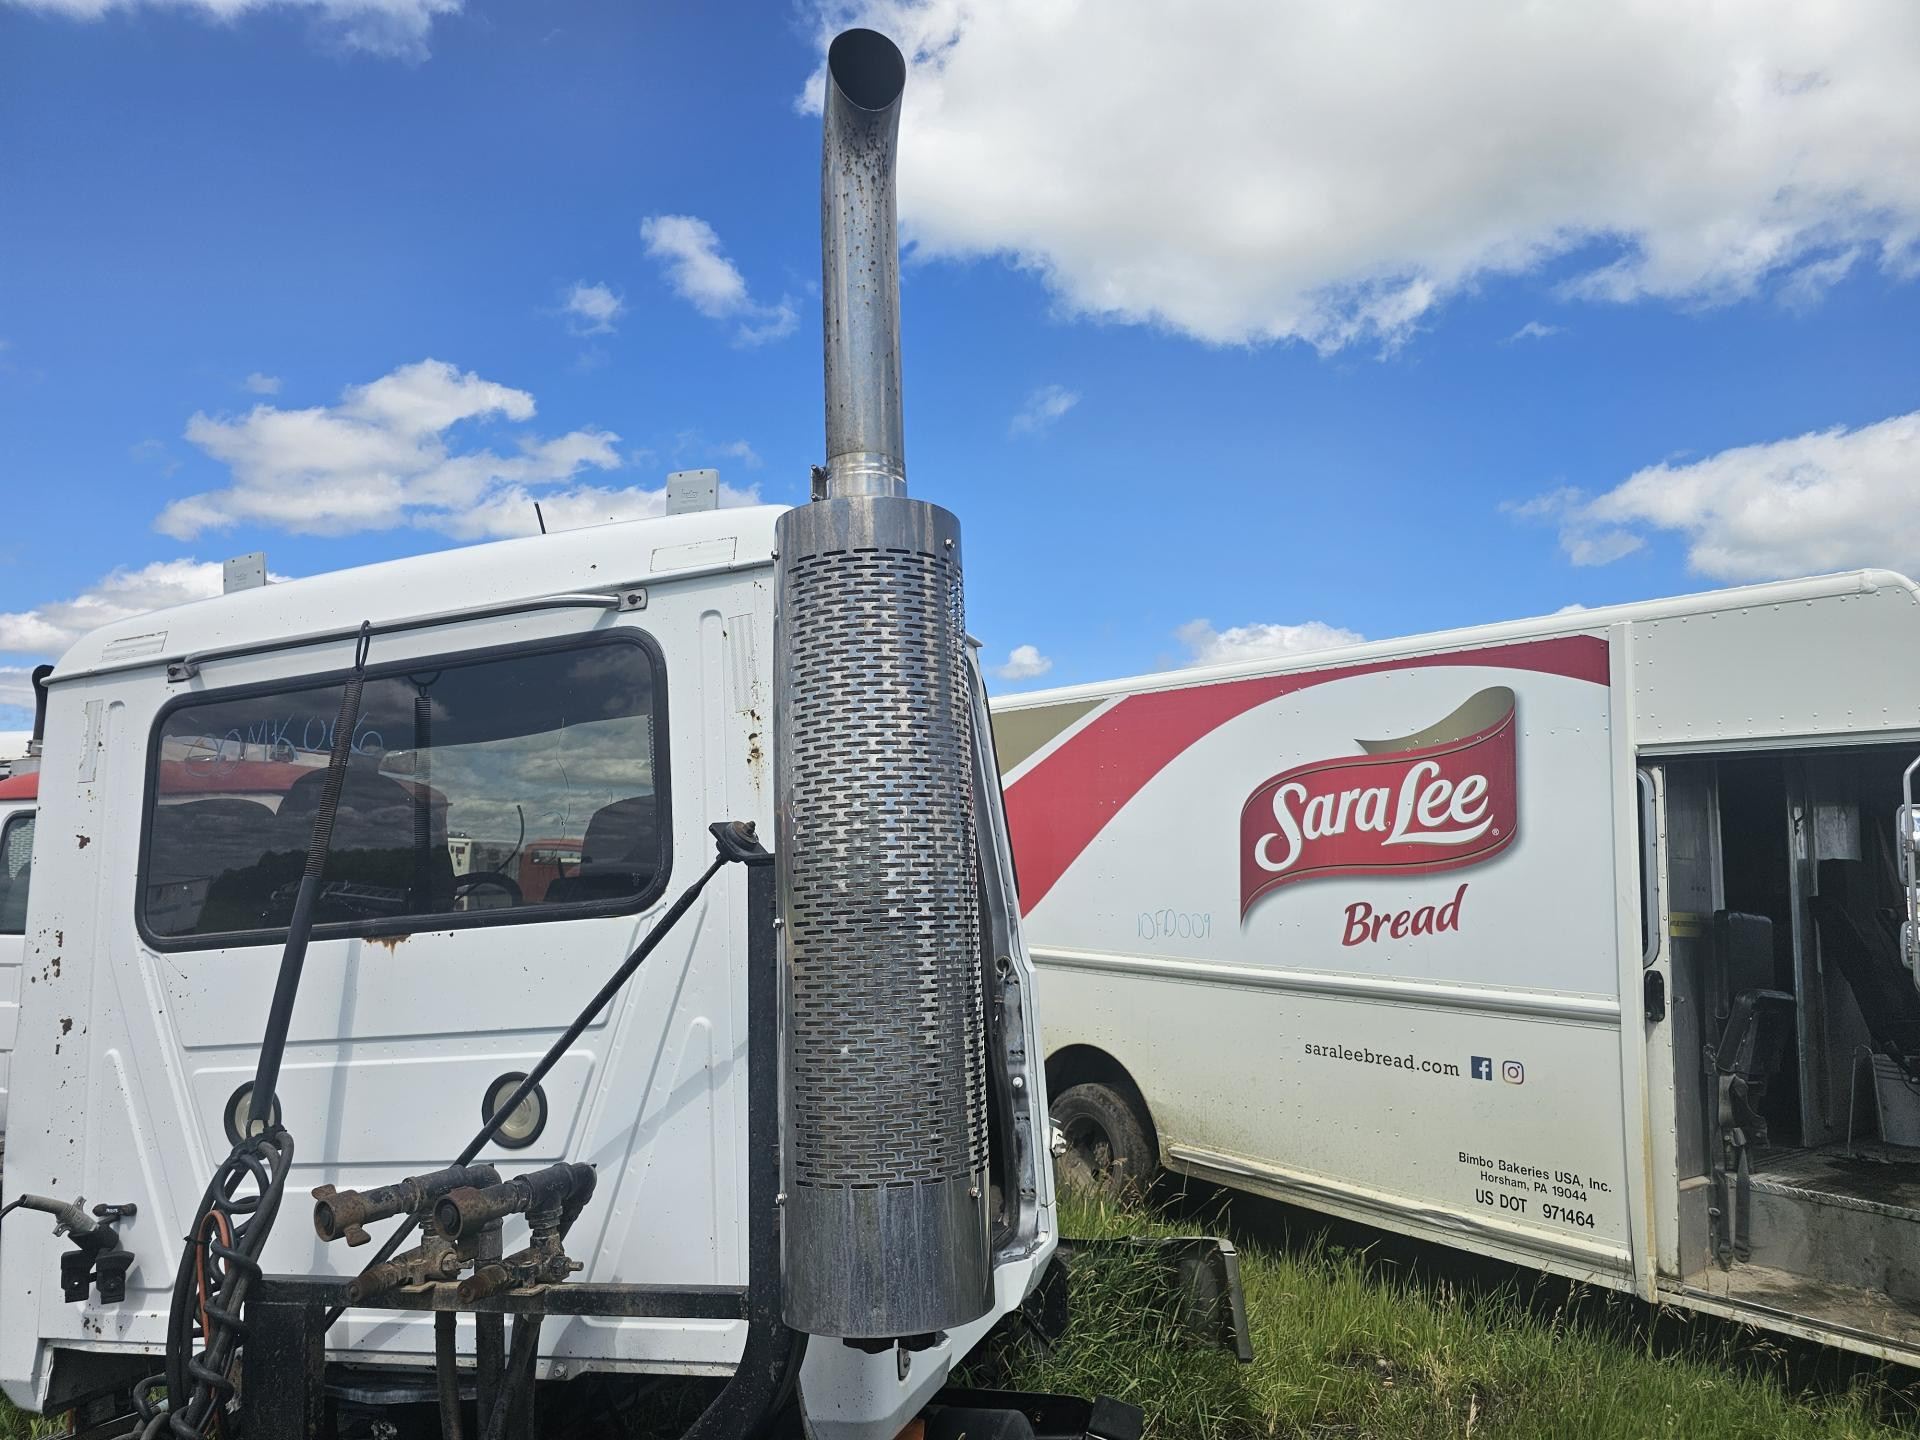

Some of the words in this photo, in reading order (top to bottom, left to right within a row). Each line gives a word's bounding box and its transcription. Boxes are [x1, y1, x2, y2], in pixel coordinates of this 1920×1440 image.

[1254, 782, 1391, 872] Sara
[1381, 760, 1494, 847] Lee
[1341, 883, 1469, 947] Bread
[1304, 1043, 1460, 1077] saraleebread.com
[1458, 1151, 1494, 1169] Bimbo
[1498, 1159, 1550, 1181] Bakeries
[1554, 1170, 1584, 1189] USA,
[1589, 1177, 1612, 1193] Inc.
[1480, 1170, 1530, 1192] Horsham,
[1534, 1182, 1548, 1194] PA
[1551, 1186, 1588, 1202] 19044
[1475, 1188, 1494, 1206] US
[1499, 1194, 1528, 1213] DOT
[1542, 1203, 1595, 1229] 971464
